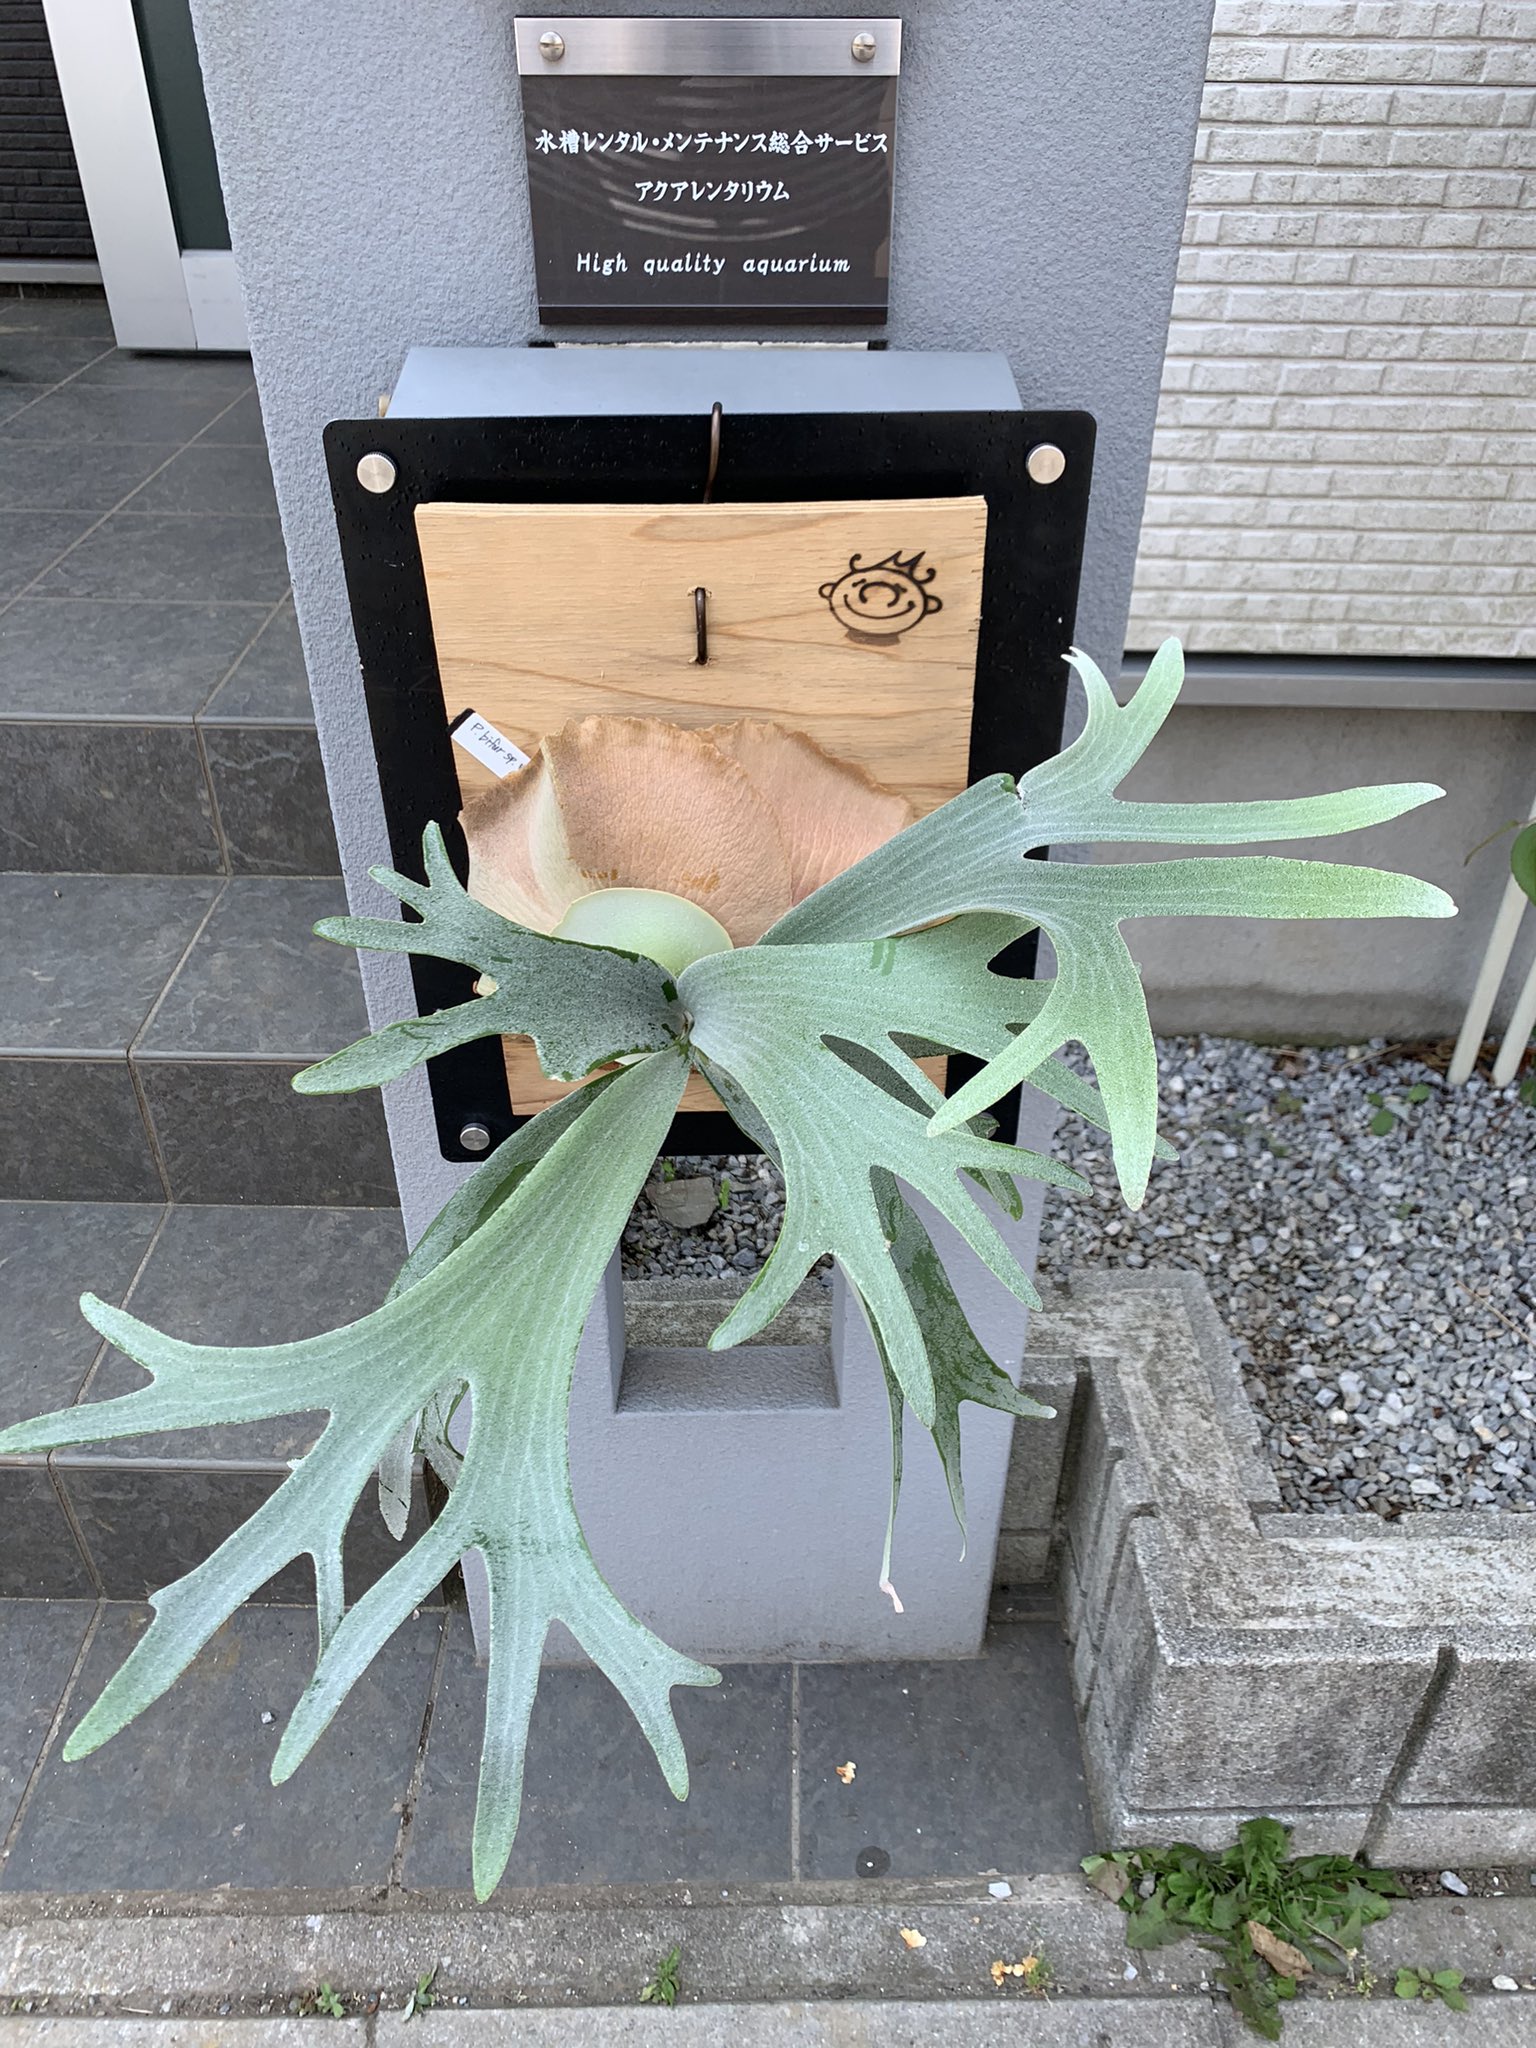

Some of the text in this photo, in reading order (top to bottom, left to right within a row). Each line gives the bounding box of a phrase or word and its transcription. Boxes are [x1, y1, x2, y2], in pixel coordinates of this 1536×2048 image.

[534, 128, 889, 155] 水槽レンタル・メンテナンス総合サービス
[634, 179, 790, 203] アクアレンタリウム
[576, 252, 851, 277] High quality aquarium
